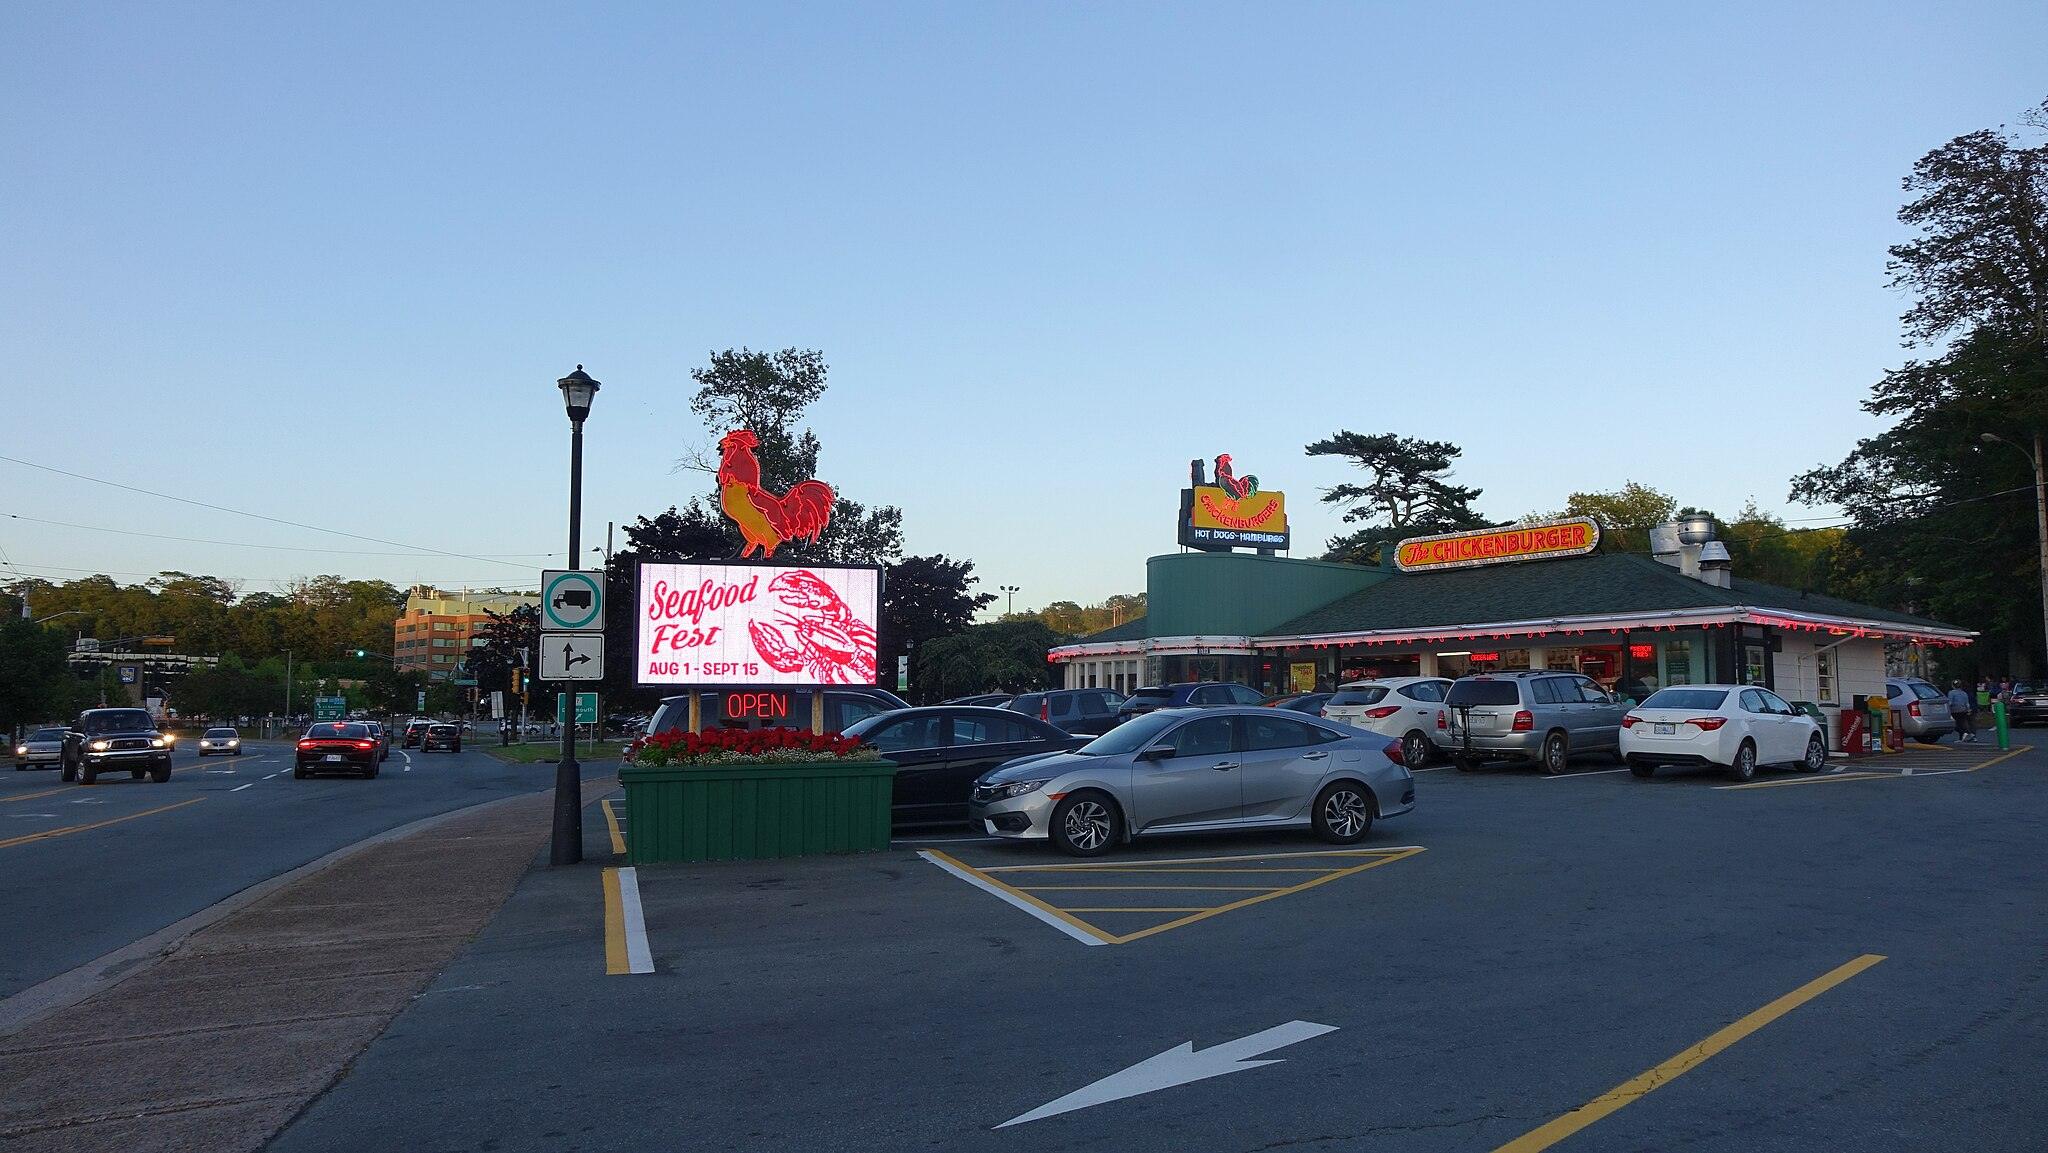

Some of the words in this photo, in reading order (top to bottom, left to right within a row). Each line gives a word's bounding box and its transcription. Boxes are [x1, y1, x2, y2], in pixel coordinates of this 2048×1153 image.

[1200, 494, 1280, 529] CHICKENBURGERS
[1195, 530, 1210, 539] HOT
[1405, 542, 1429, 564] The
[1432, 526, 1586, 560] CHICKENBURGER
[649, 575, 758, 625] Seafood
[651, 623, 722, 655] Fest
[649, 663, 678, 675] AUG
[683, 663, 690, 675] 1
[703, 663, 739, 676] SEPT
[743, 663, 759, 676] 15
[727, 693, 788, 719] OPEN
